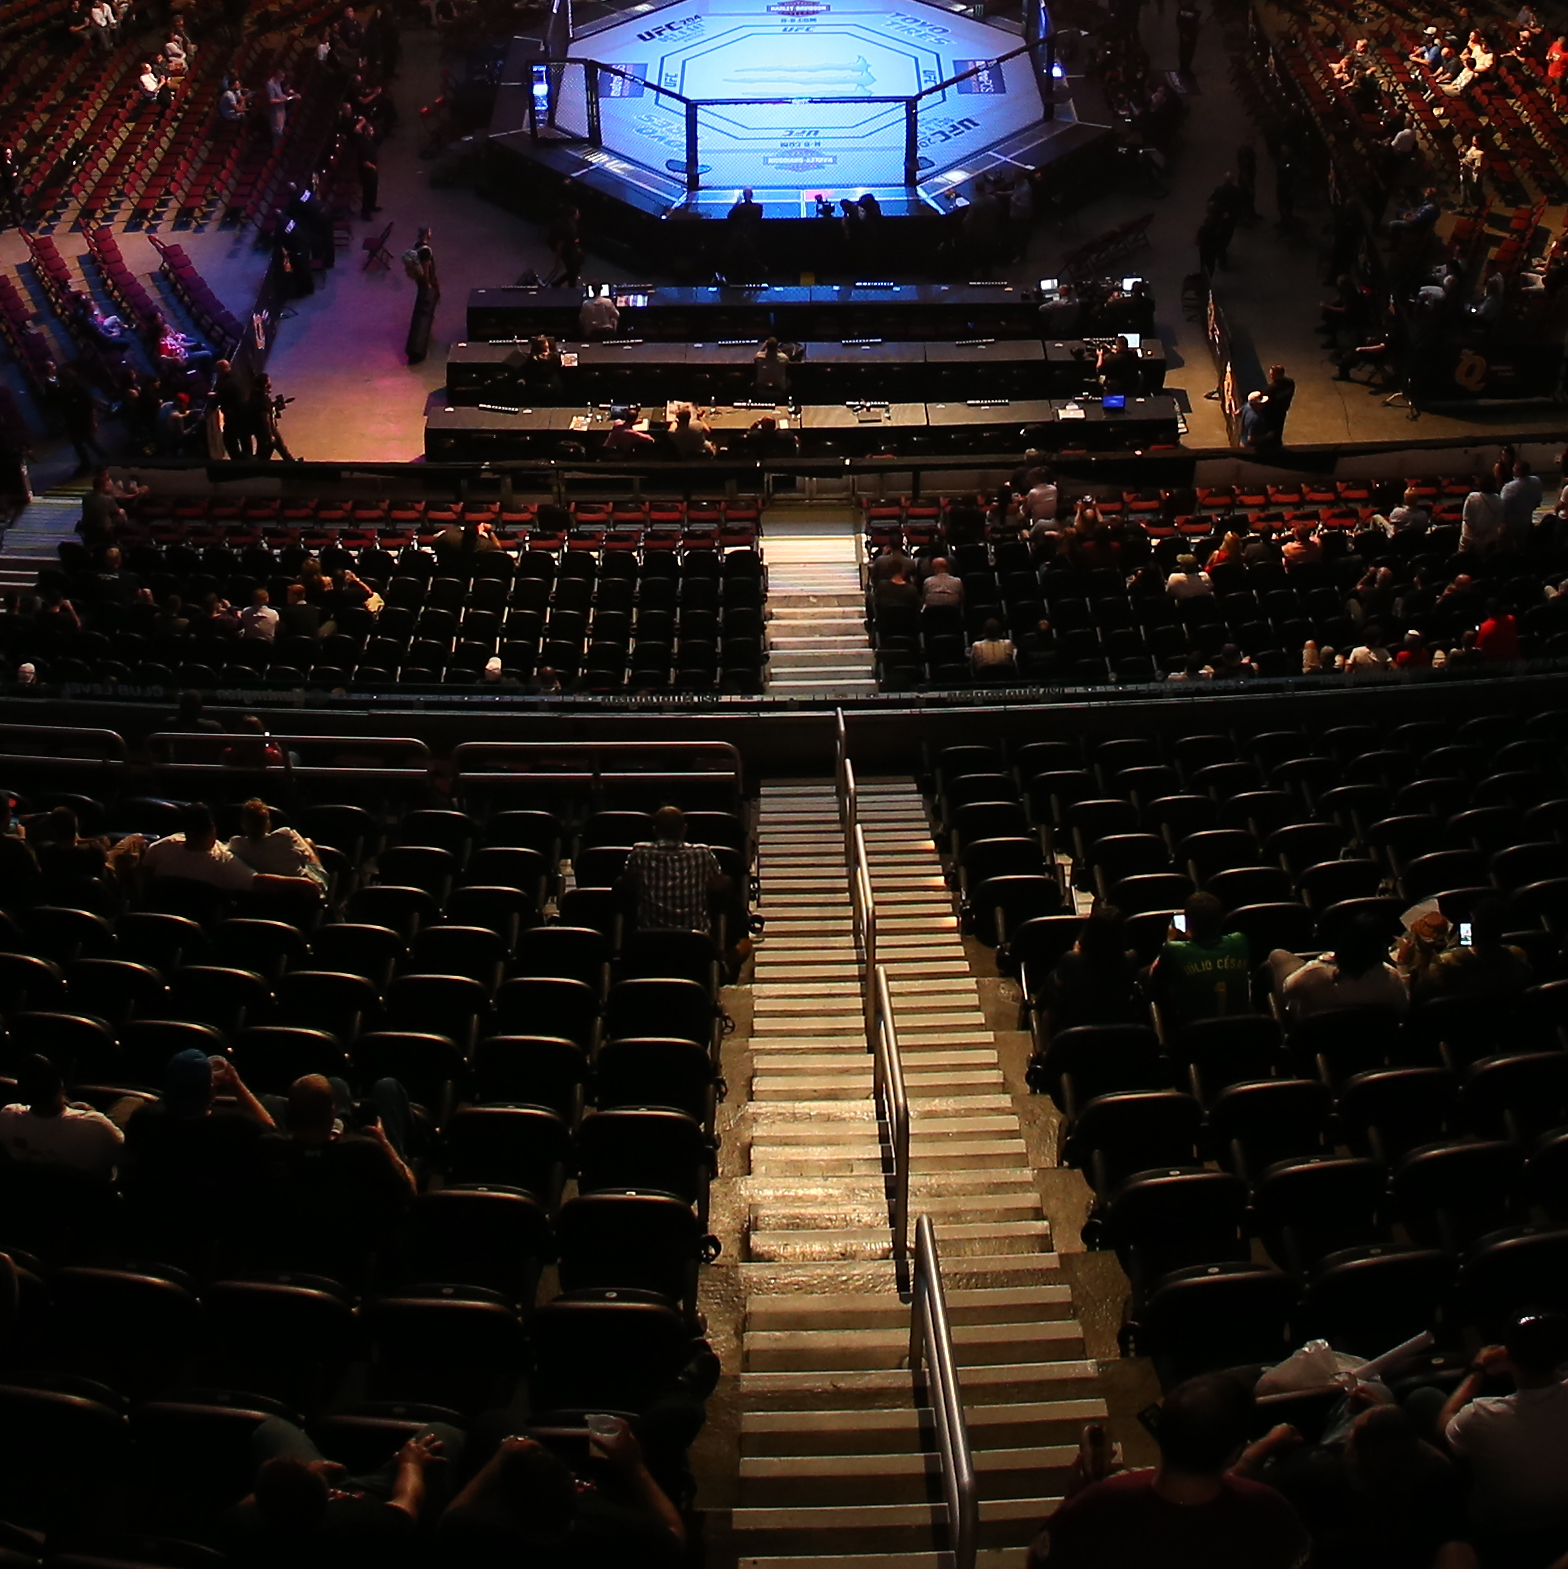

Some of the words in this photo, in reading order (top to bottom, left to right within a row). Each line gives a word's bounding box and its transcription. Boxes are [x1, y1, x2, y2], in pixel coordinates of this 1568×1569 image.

[637, 21, 682, 42] UFC
[884, 21, 951, 45] TIRES
[891, 12, 950, 34] TOYO
[664, 72, 678, 87] UFC
[922, 70, 937, 86] UFC
[929, 118, 980, 144] UFC
